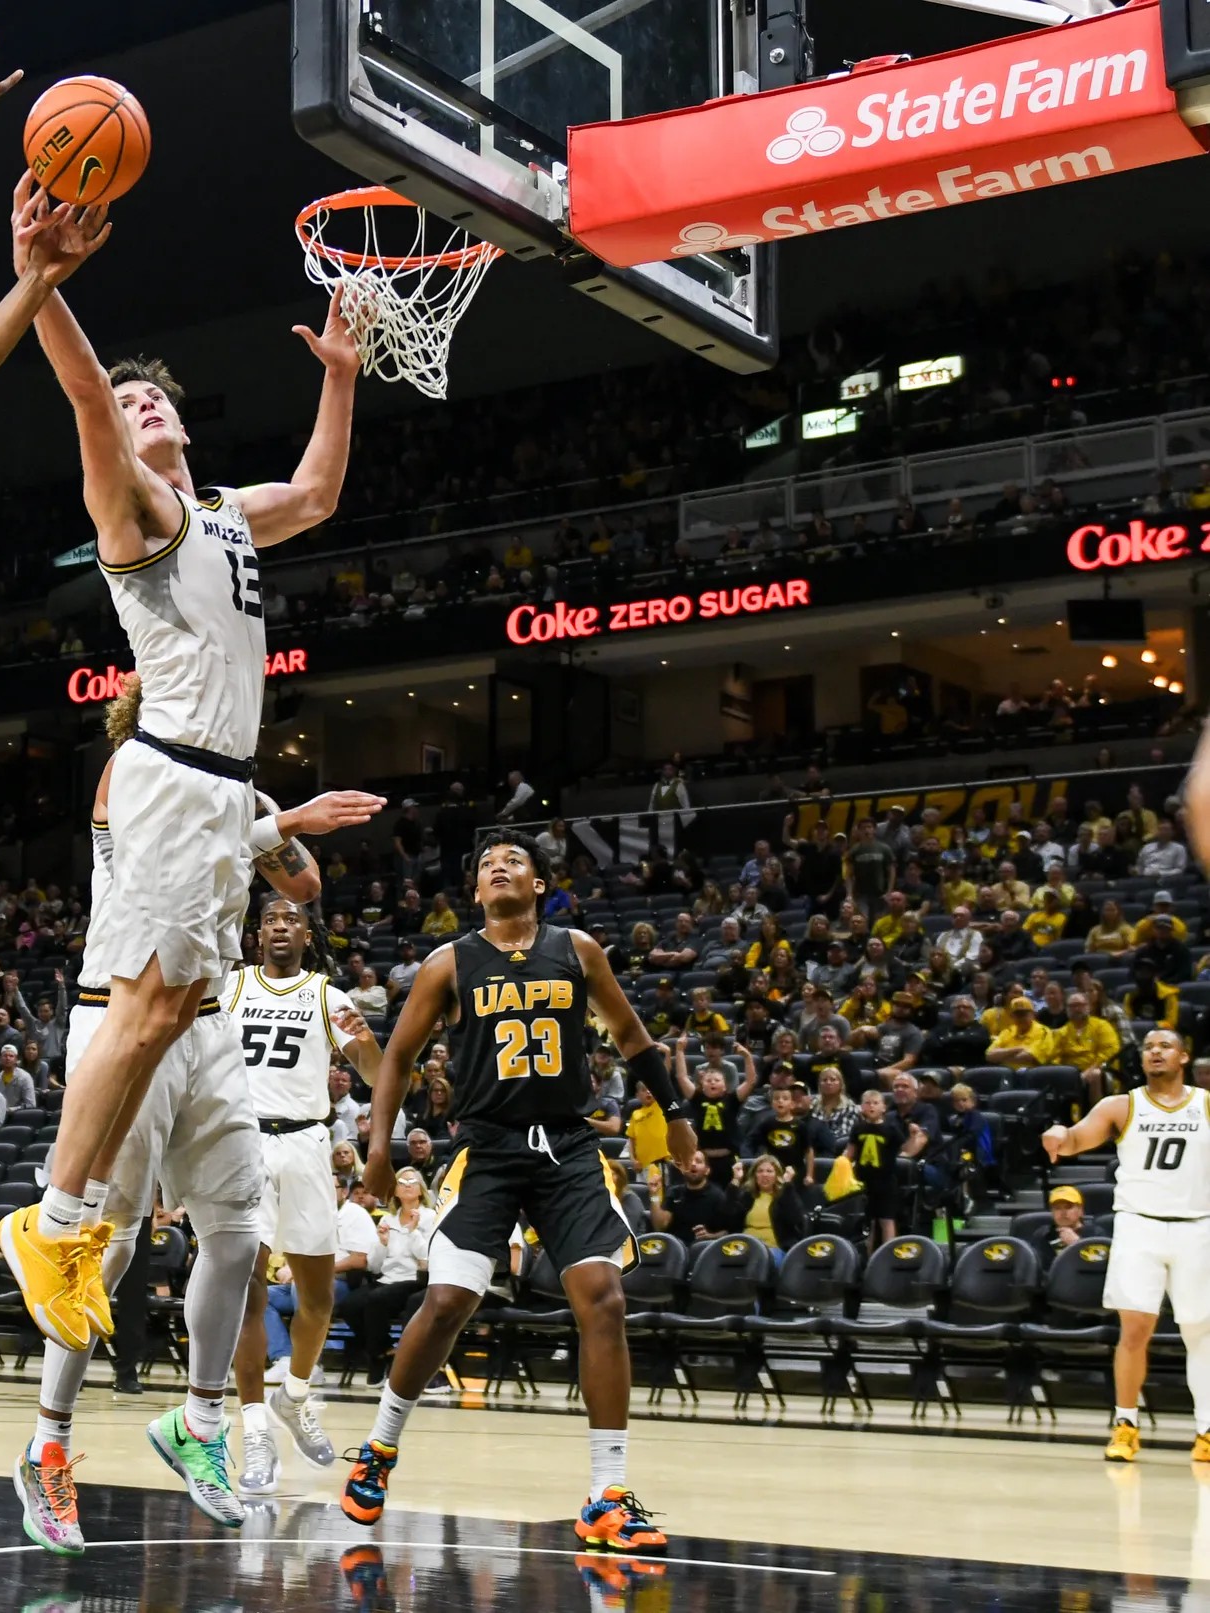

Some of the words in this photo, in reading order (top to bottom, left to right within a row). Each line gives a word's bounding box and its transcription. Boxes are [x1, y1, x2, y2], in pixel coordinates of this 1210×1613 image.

[32, 125, 74, 178] ELITE
[1067, 520, 1187, 570] Coke
[507, 602, 598, 644] Coke
[609, 596, 690, 630] ZERO
[699, 580, 808, 617] SUGAR
[68, 665, 136, 703] Cok
[241, 1007, 314, 1022] MIZZOU
[473, 980, 573, 1017] UAPB
[241, 1025, 308, 1069] 55
[494, 1017, 562, 1080] 23
[1138, 1123, 1199, 1132] MIZZOU
[1143, 1137, 1187, 1170] 10
